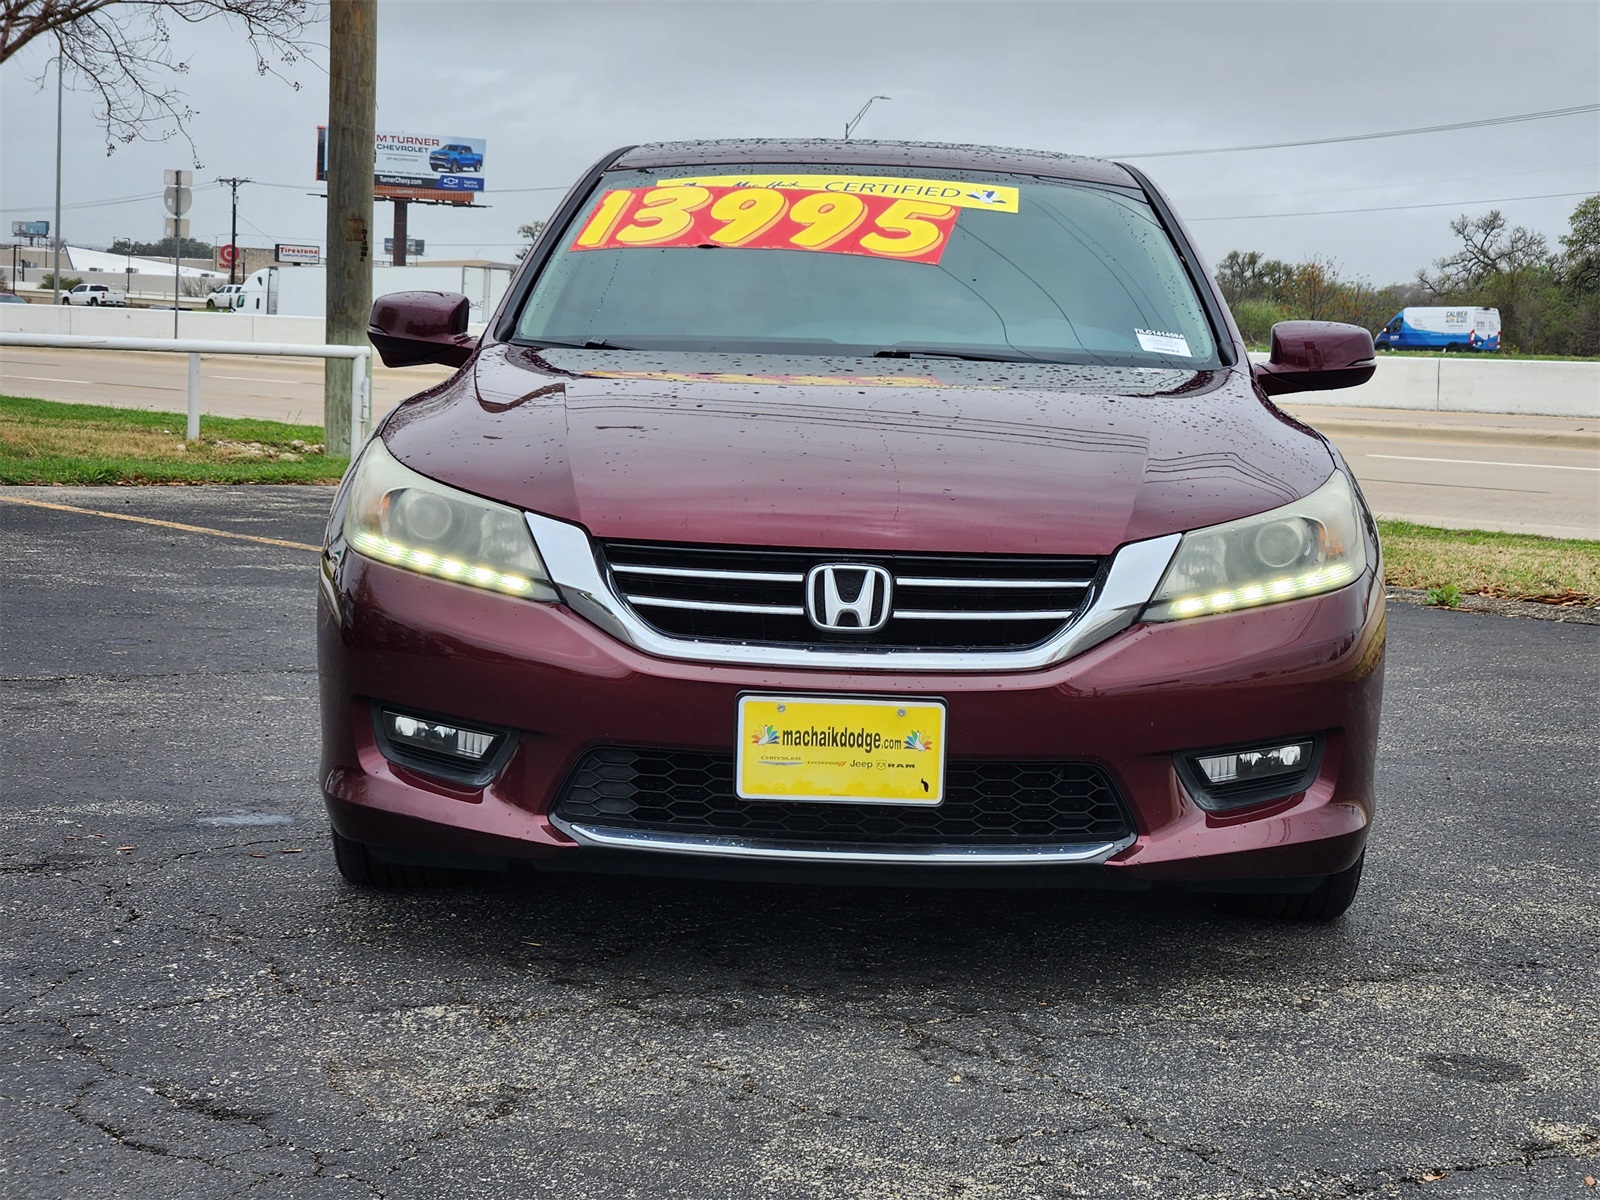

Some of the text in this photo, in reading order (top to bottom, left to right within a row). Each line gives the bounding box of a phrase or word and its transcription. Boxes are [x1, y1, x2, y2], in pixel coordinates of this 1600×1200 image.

[391, 135, 440, 147] TURNER
[376, 143, 430, 153] CHEVROLET
[379, 175, 423, 186] TurnerChevy.com
[825, 182, 961, 198] CERTIFIED
[577, 186, 955, 257] 13995
[279, 246, 319, 255] Firestone
[782, 726, 902, 753] machaikdodge.com
[850, 759, 873, 769] Jeep
